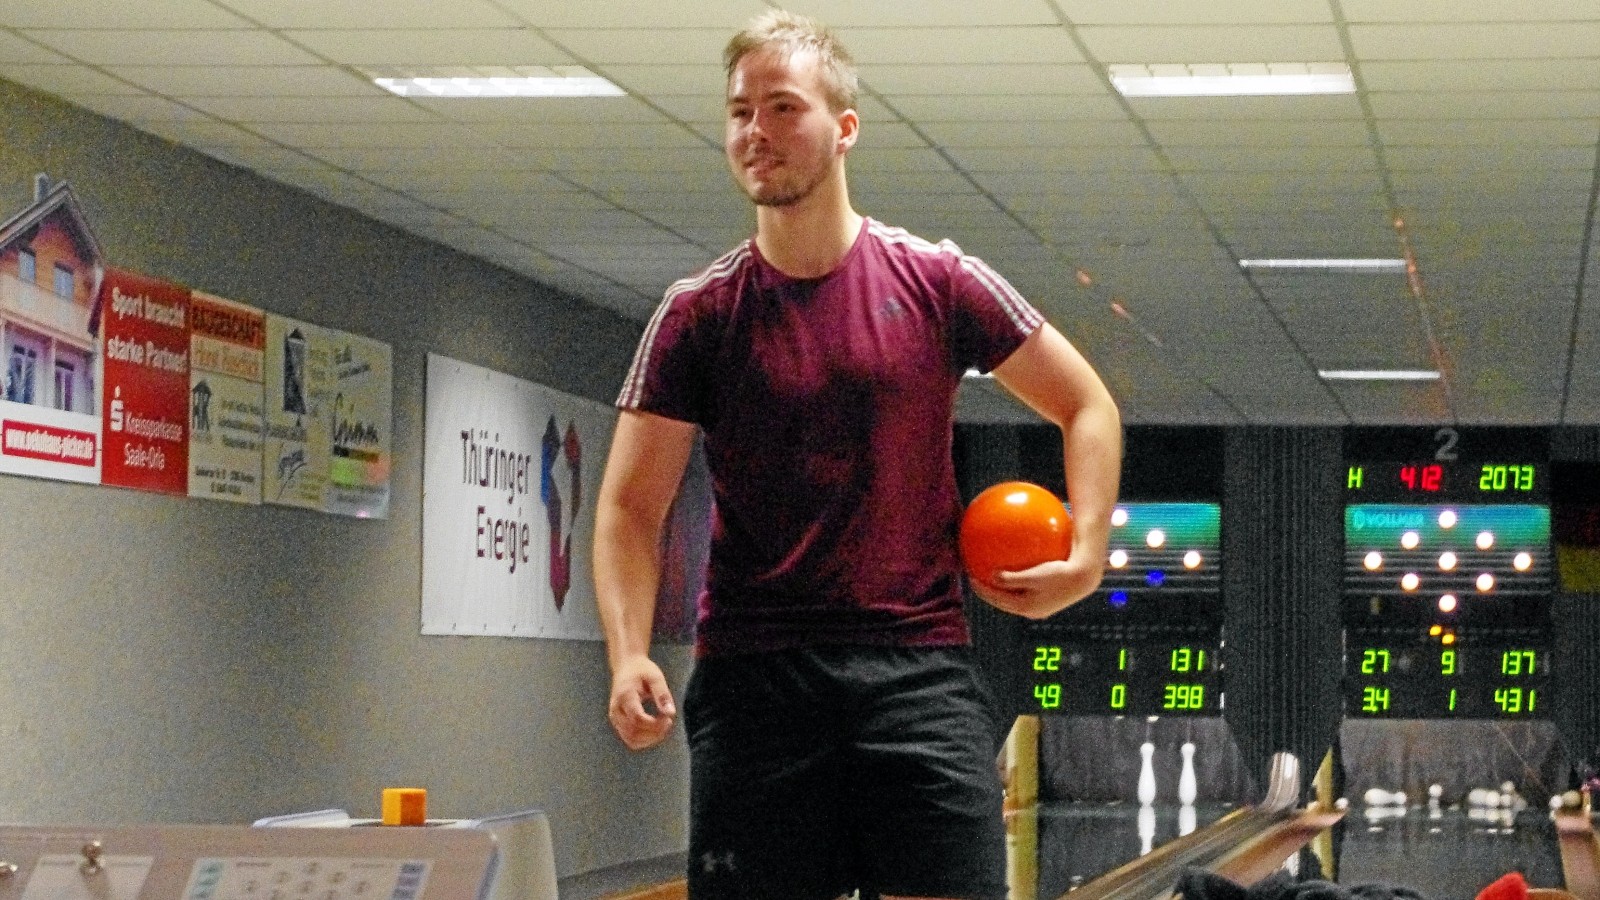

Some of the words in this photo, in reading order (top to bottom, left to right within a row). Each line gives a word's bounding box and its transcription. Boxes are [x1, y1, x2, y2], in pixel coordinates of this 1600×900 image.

[112, 286, 143, 320] Sport
[145, 295, 185, 329] braucht
[107, 334, 144, 365] starke
[124, 442, 165, 471] Saale-Orla
[1434, 428, 1459, 461] 2
[461, 428, 531, 504] Thüringer
[1347, 466, 1363, 488] H
[1400, 465, 1442, 491] 412
[1479, 464, 1535, 491] 2073
[476, 505, 530, 574] Energie
[1033, 647, 1061, 671] 22
[1171, 648, 1205, 672] 131
[1361, 650, 1391, 674] 27
[1441, 650, 1455, 675] 9
[1502, 651, 1536, 675] 137
[1034, 684, 1061, 708] 49
[1110, 684, 1125, 709] 0
[1163, 685, 1204, 709] 398
[1361, 687, 1391, 713] 34
[1494, 688, 1536, 713] 431
